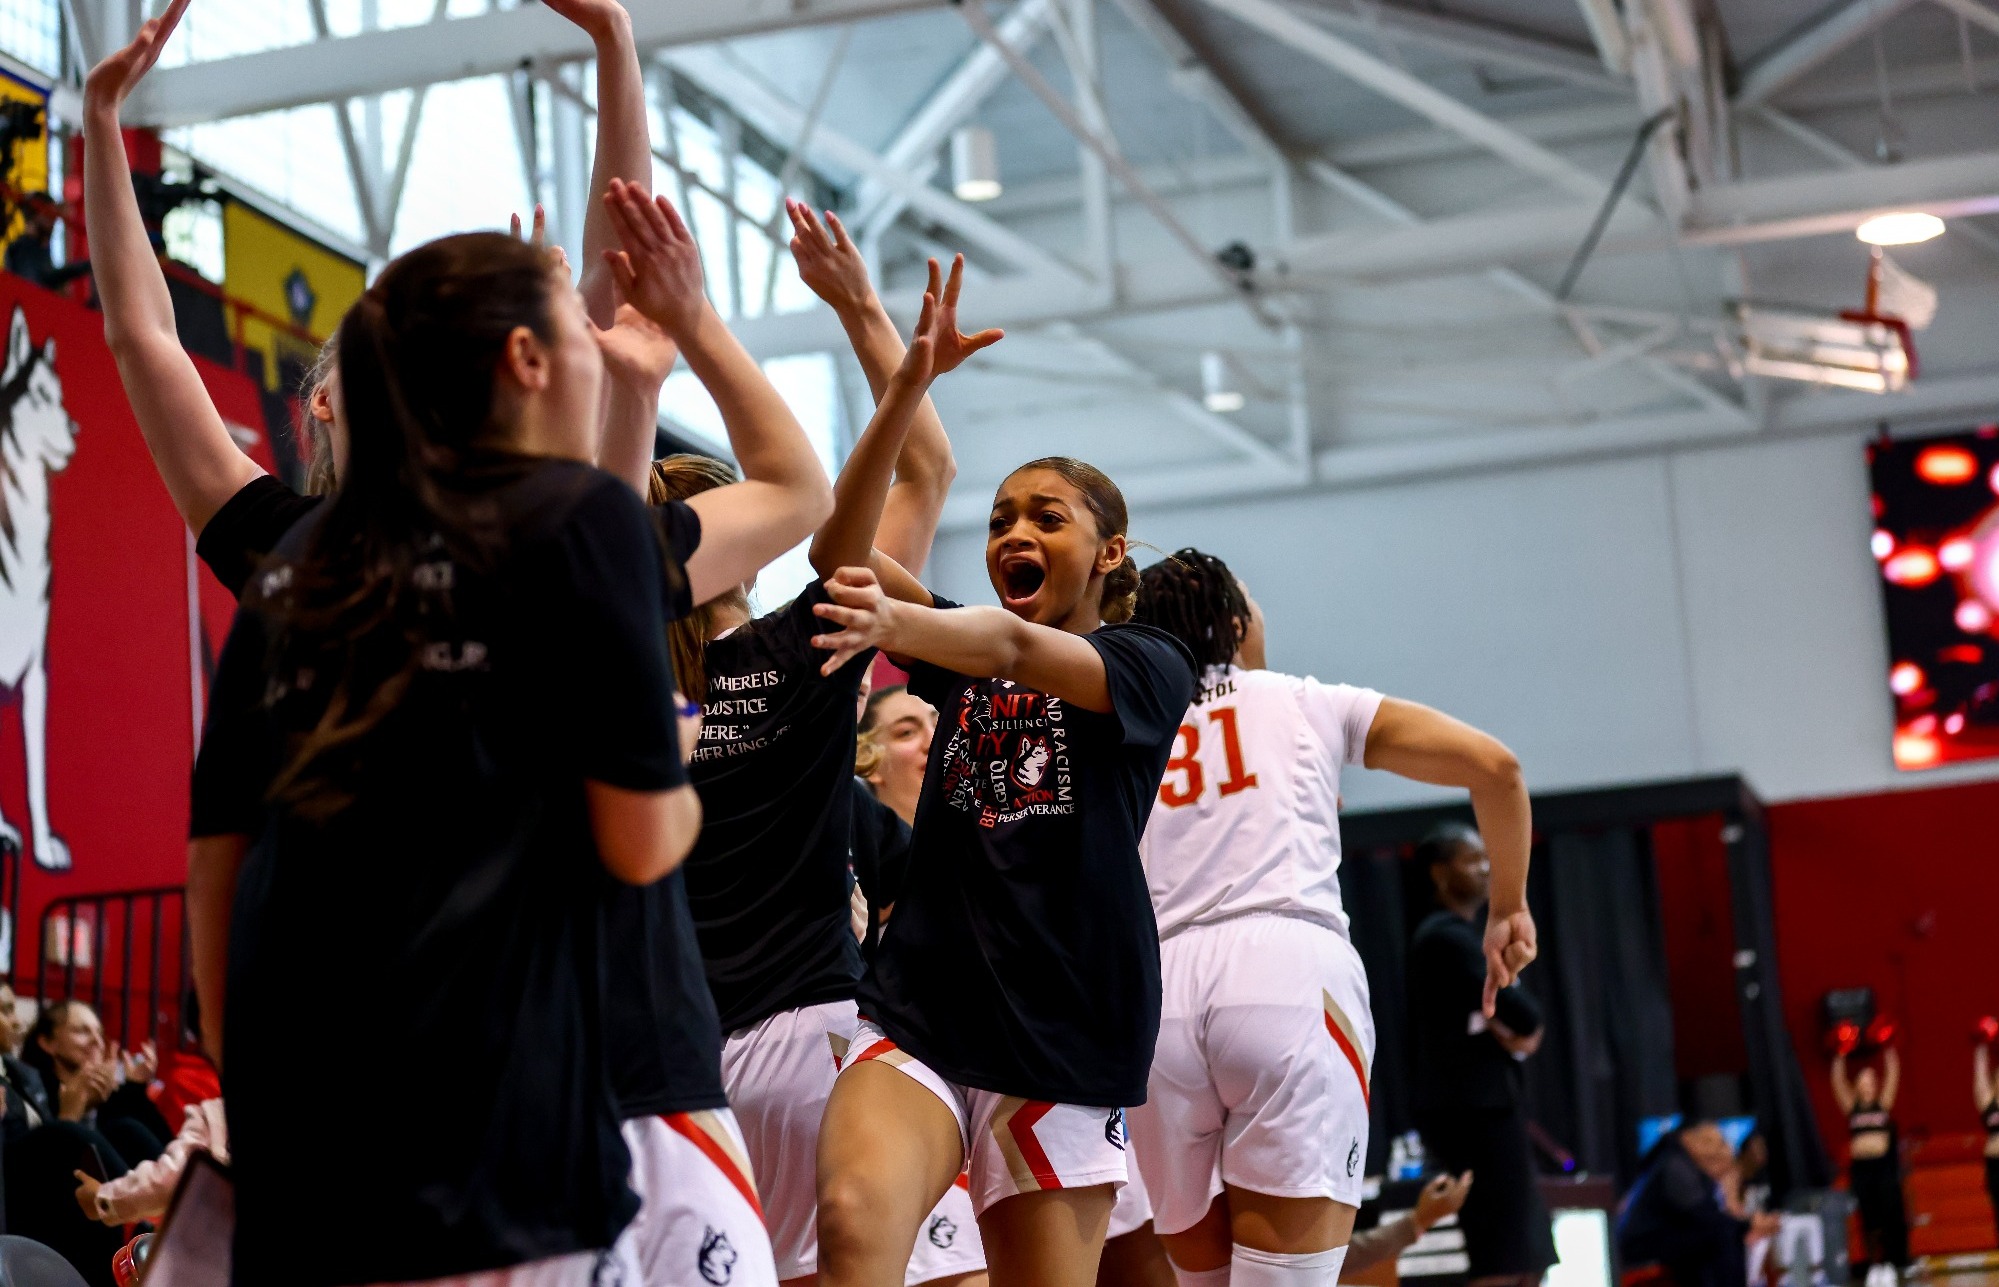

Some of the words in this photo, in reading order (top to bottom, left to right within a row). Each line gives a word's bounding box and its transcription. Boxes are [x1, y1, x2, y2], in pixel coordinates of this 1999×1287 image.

[763, 670, 779, 687] IS
[1051, 727, 1073, 802] RACISM
[1160, 706, 1258, 809] 31
